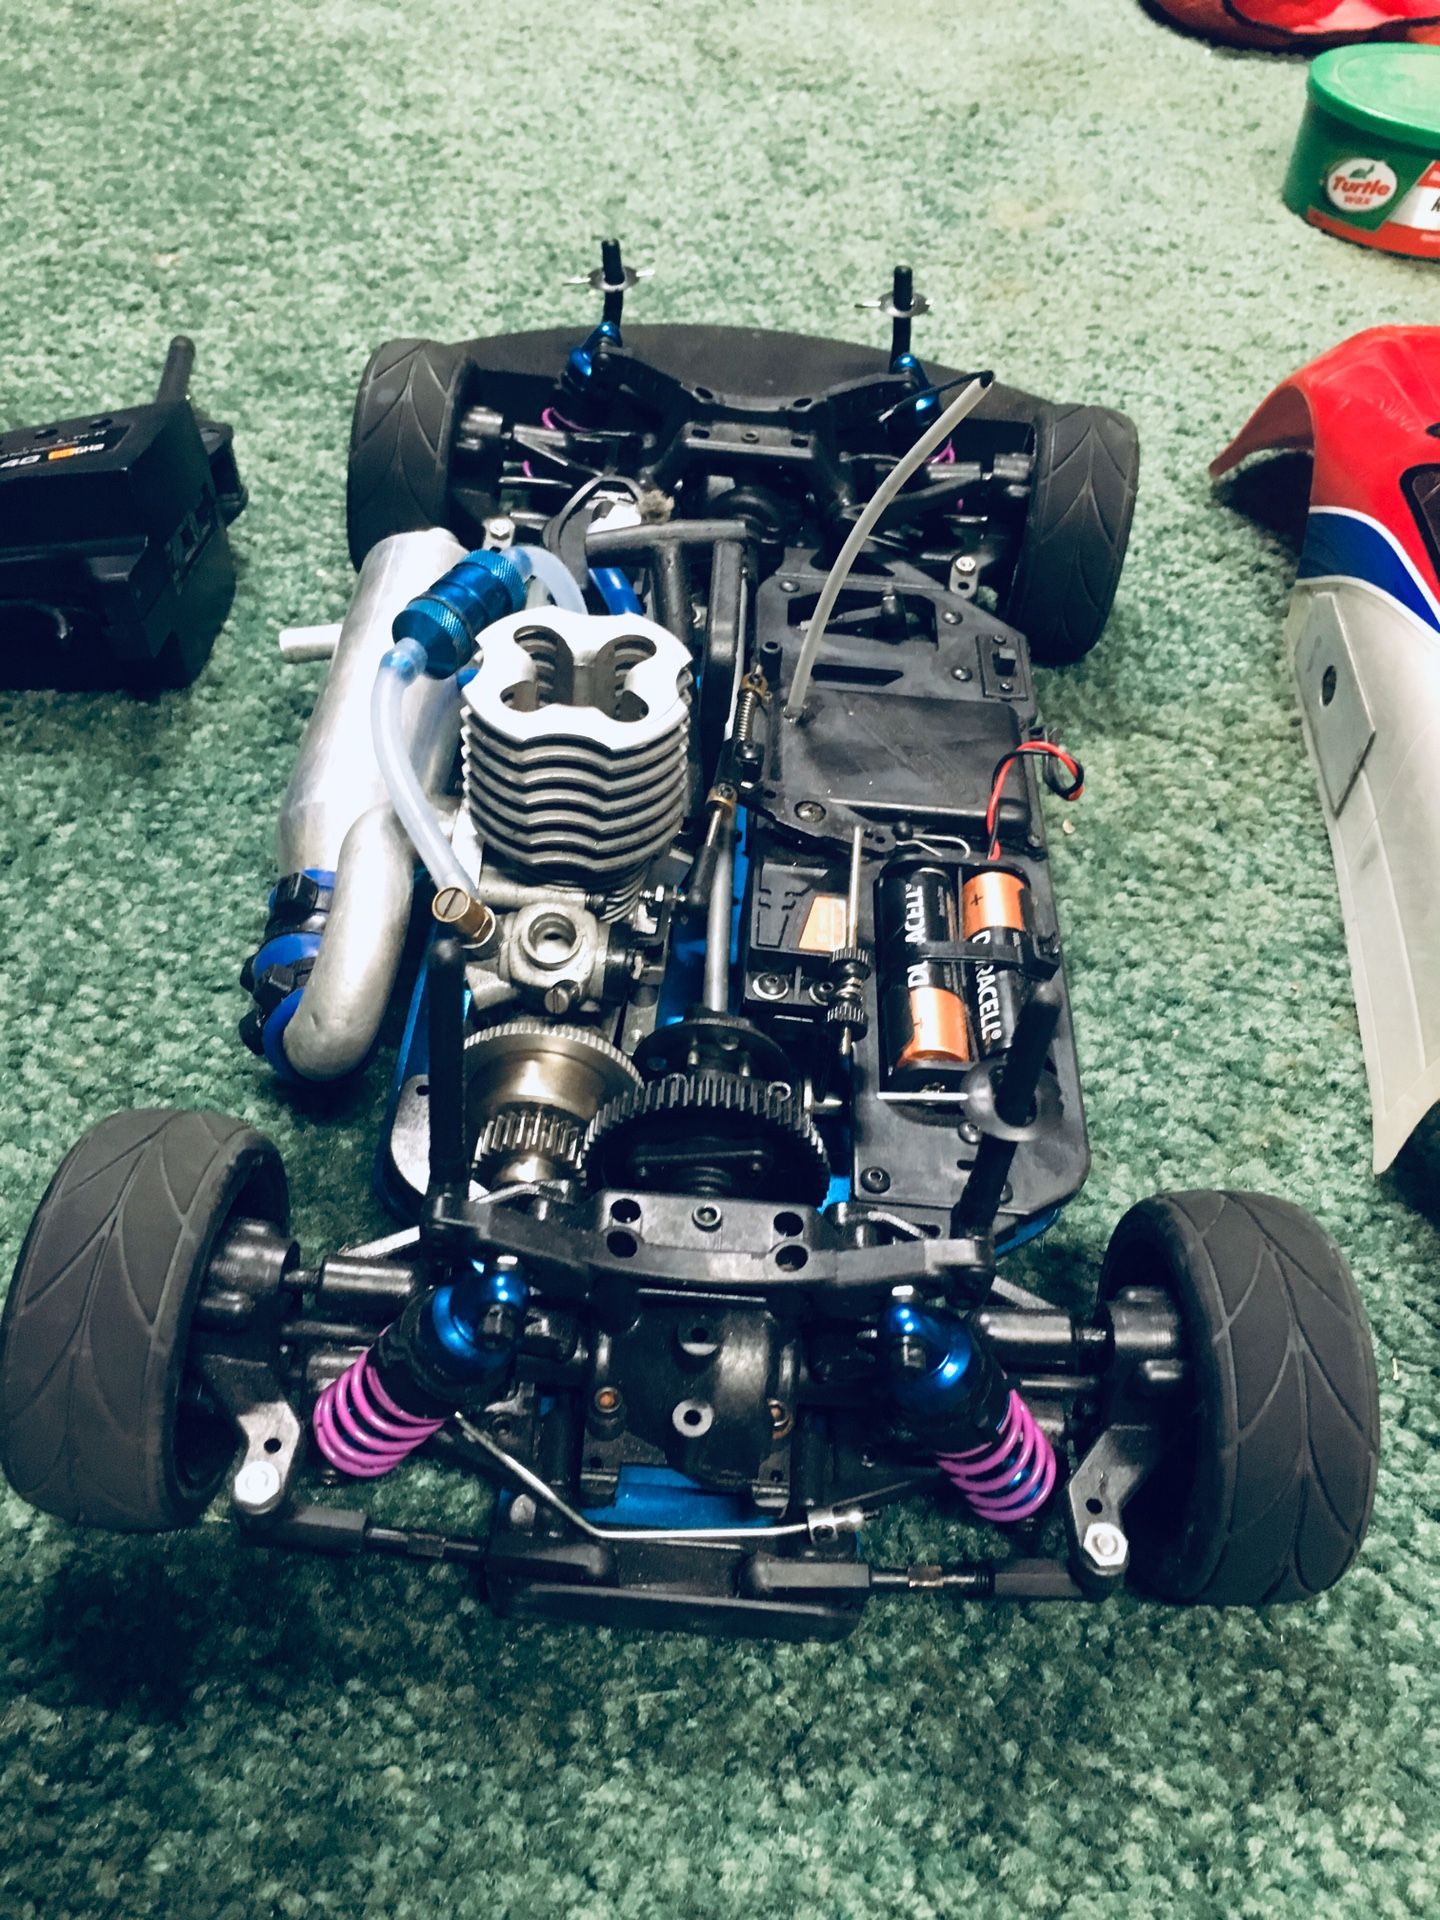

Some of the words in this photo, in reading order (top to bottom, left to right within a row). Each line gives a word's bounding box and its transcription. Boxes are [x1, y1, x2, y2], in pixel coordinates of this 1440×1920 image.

[1332, 176, 1390, 195] Turtle
[904, 884, 930, 988] DACELL
[971, 930, 1002, 1041] DRACELL
